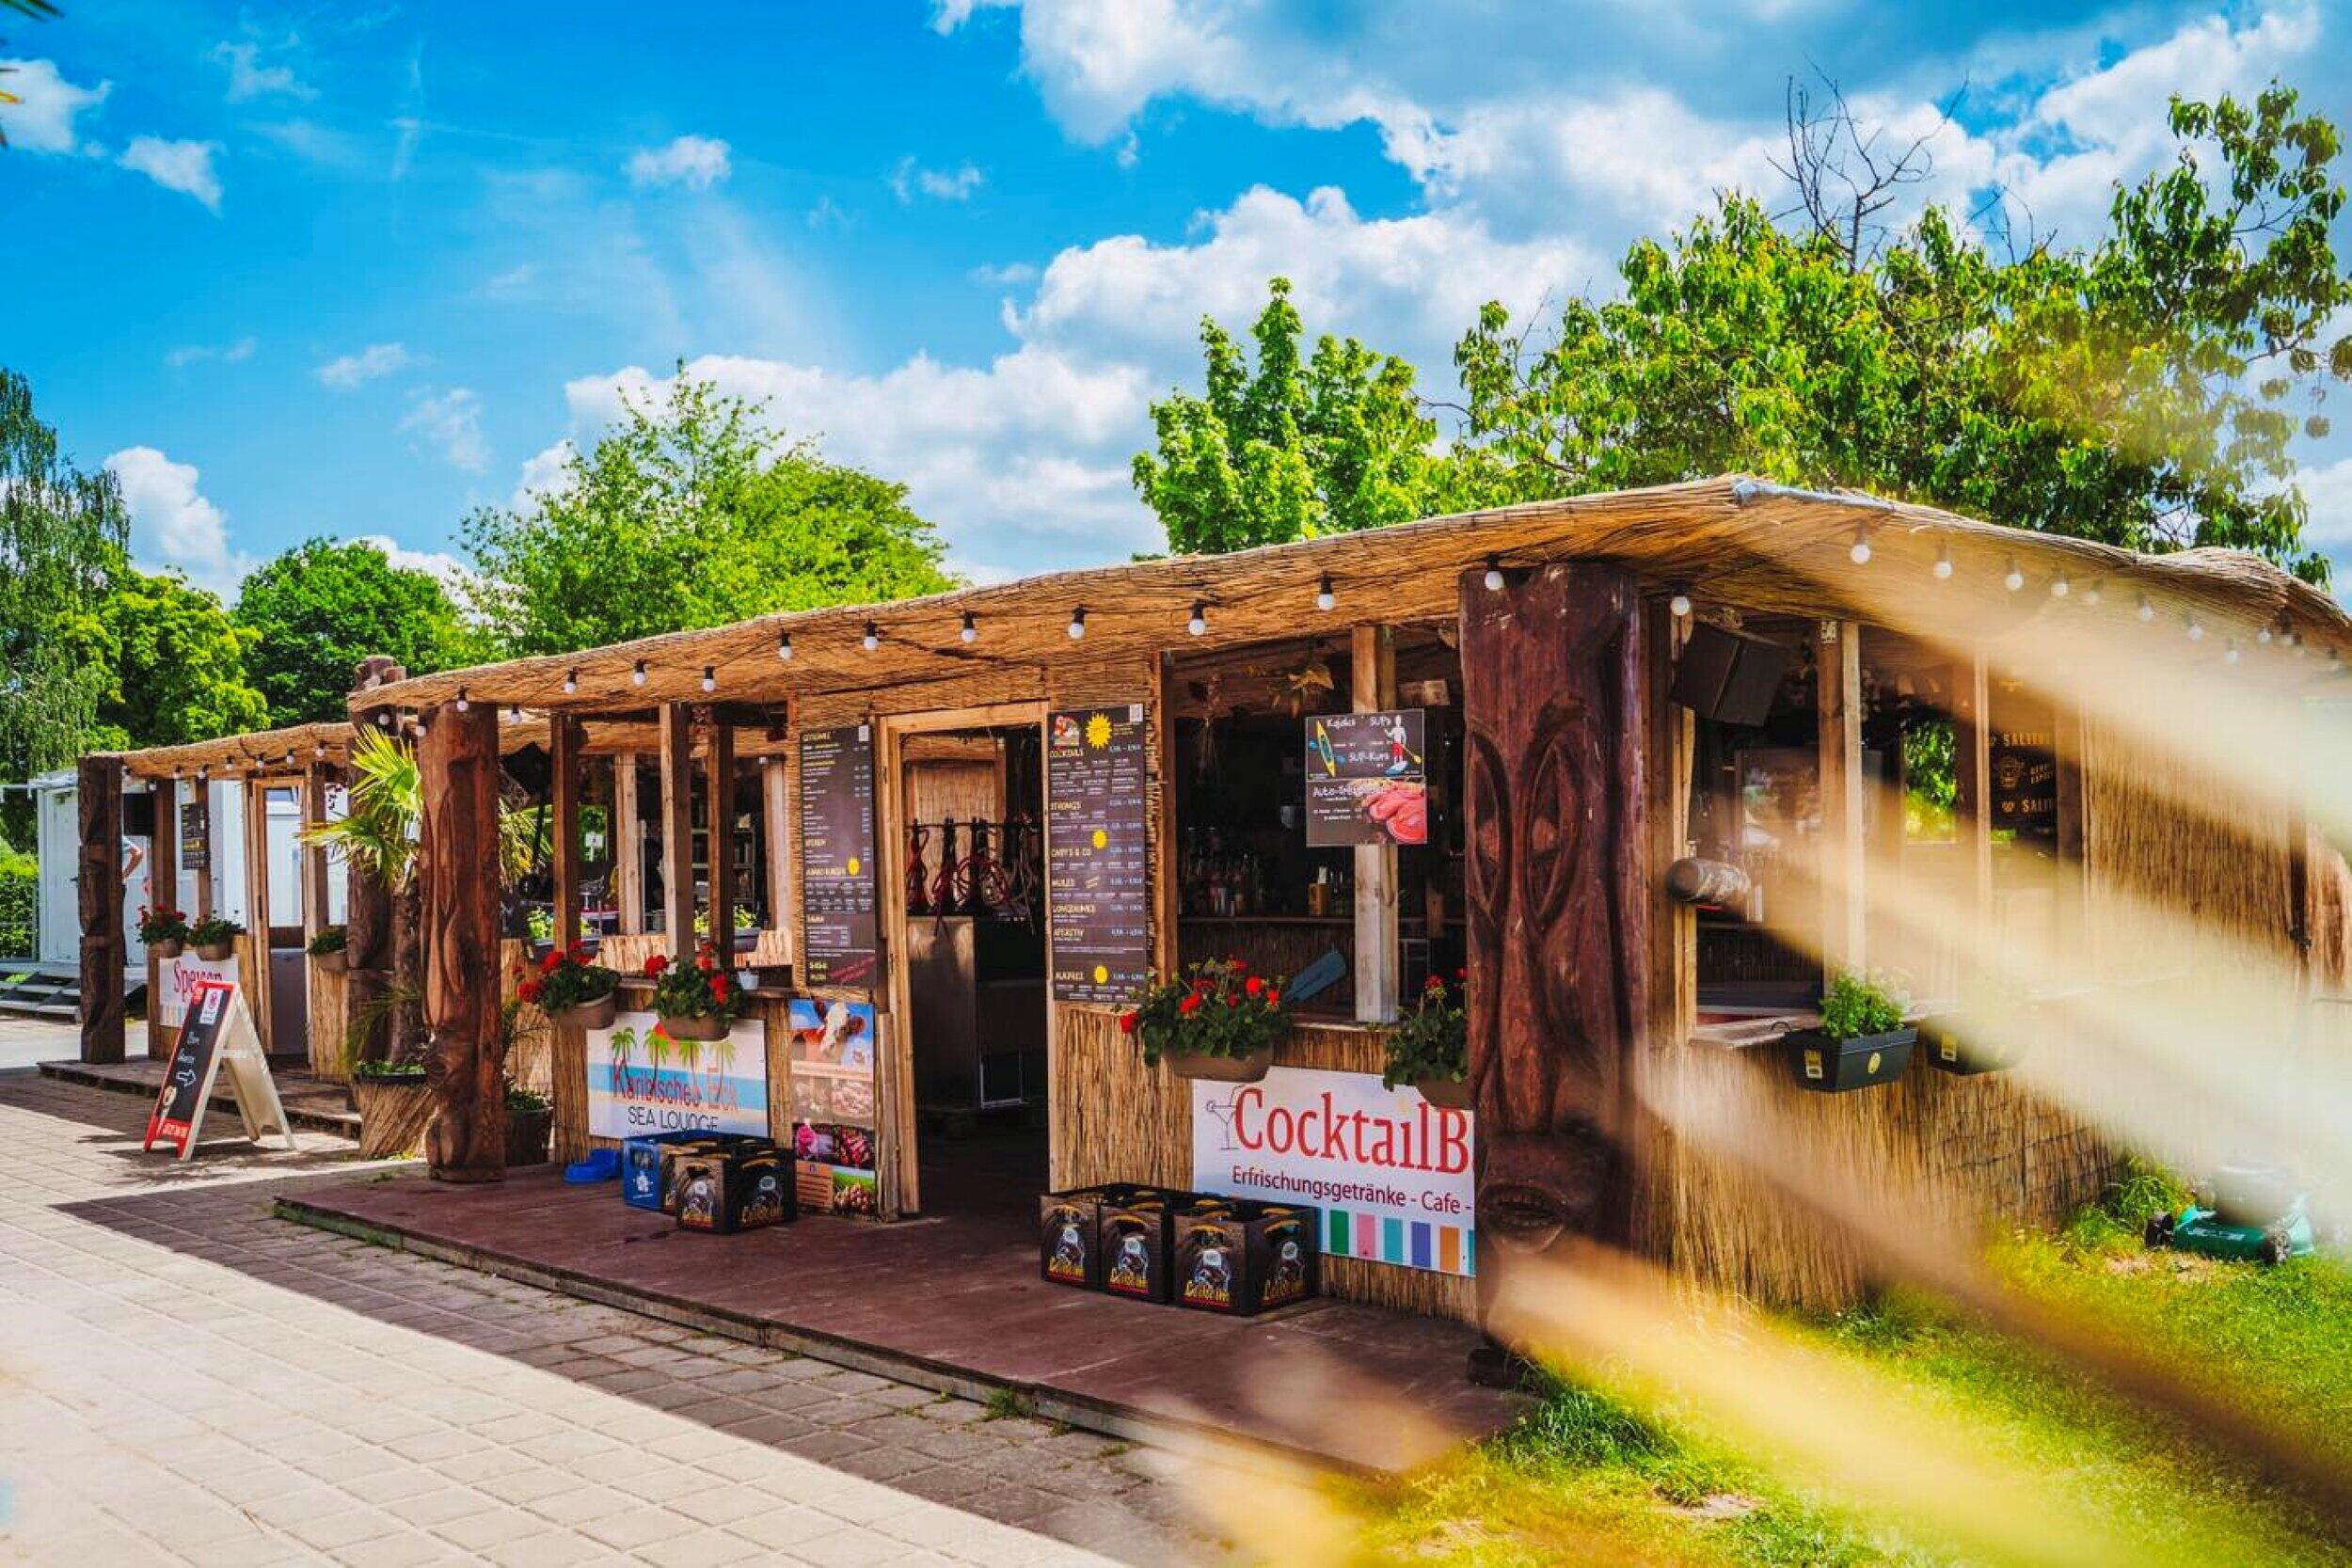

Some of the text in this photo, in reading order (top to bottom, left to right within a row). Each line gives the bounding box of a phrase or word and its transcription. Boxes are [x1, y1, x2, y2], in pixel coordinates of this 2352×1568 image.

[628, 1106, 656, 1127] SEA
[1234, 1086, 1474, 1175] CocktailB
[1232, 1165, 1406, 1209] Erfrischungsgetränke
[1422, 1191, 1461, 1214] Cafe
